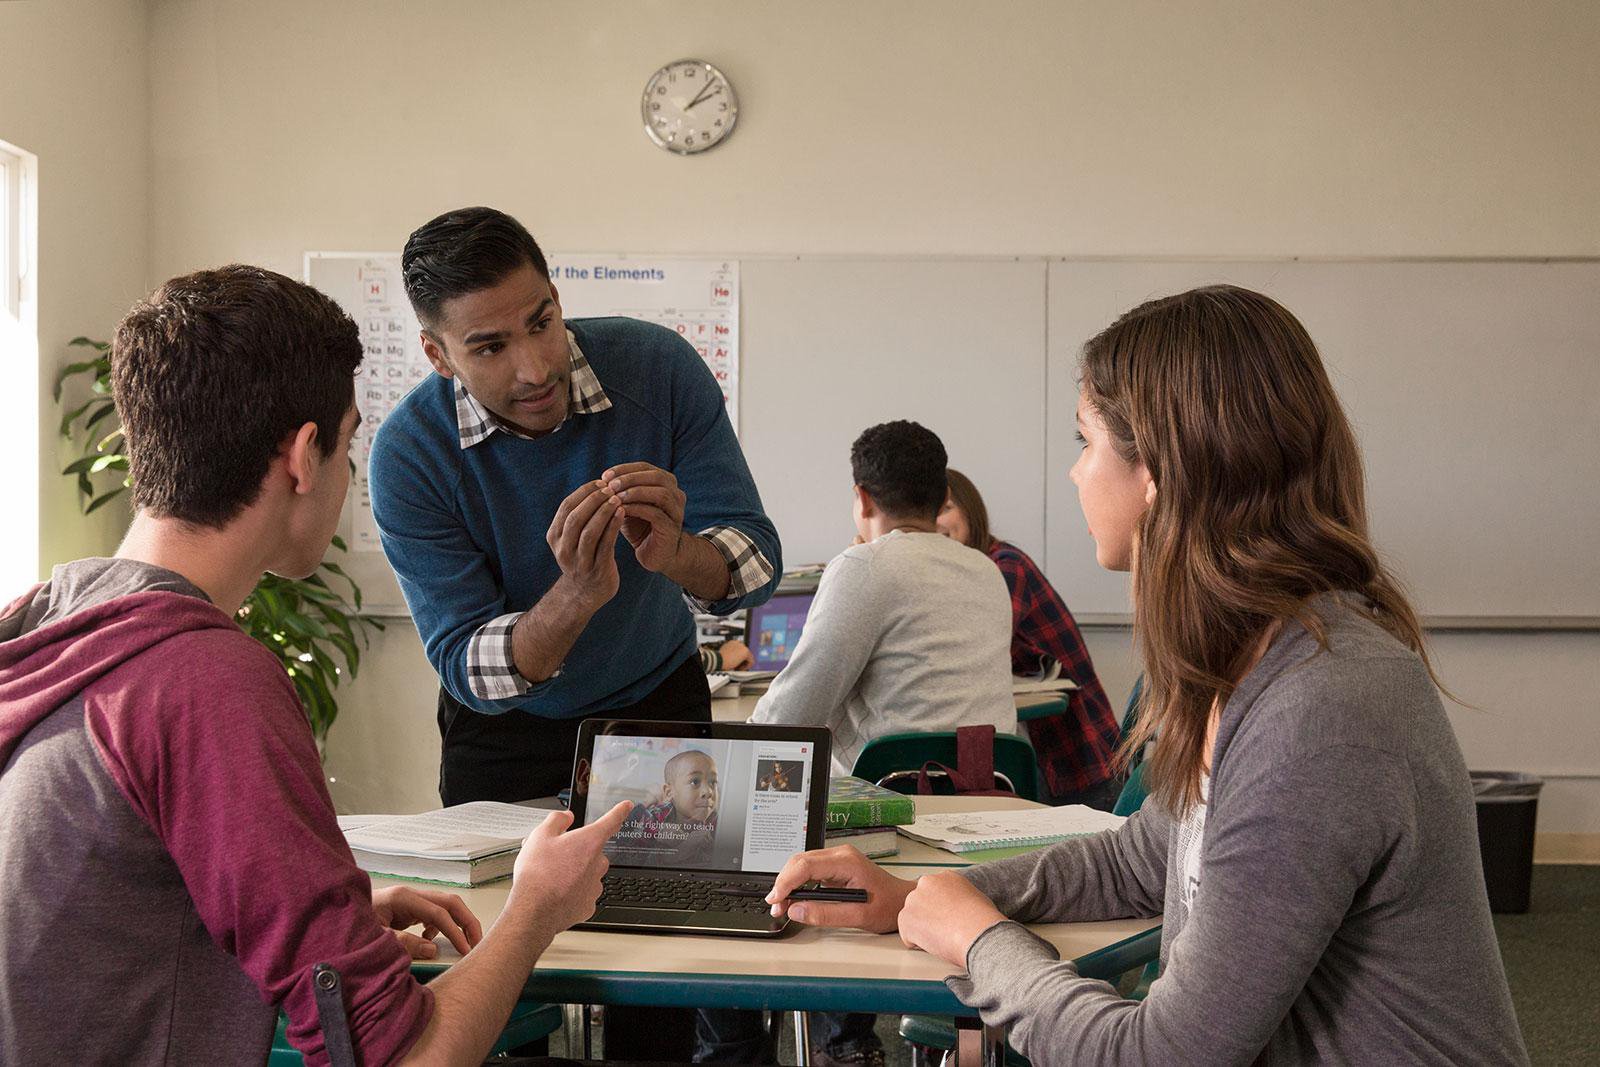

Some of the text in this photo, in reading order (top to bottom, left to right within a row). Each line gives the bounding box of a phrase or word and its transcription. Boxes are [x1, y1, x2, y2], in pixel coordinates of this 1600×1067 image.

[719, 102, 727, 111] 3
[549, 267, 665, 280] of the Elements
[371, 285, 380, 294] H
[714, 287, 730, 297] He
[370, 322, 380, 332] Li
[388, 322, 402, 332] Be
[676, 324, 686, 334] O
[698, 325, 706, 334] F
[715, 324, 730, 335] Ne
[367, 346, 382, 354] Na
[387, 346, 404, 357] Mg
[715, 348, 729, 358] Ar
[370, 368, 379, 377] K
[387, 368, 403, 378] Ca
[715, 371, 729, 380] Kr
[366, 391, 383, 400] Rb
[631, 820, 643, 829] the
[645, 821, 664, 831] right
[666, 822, 681, 831] way
[693, 823, 715, 832] teach
[653, 832, 689, 841] children?
